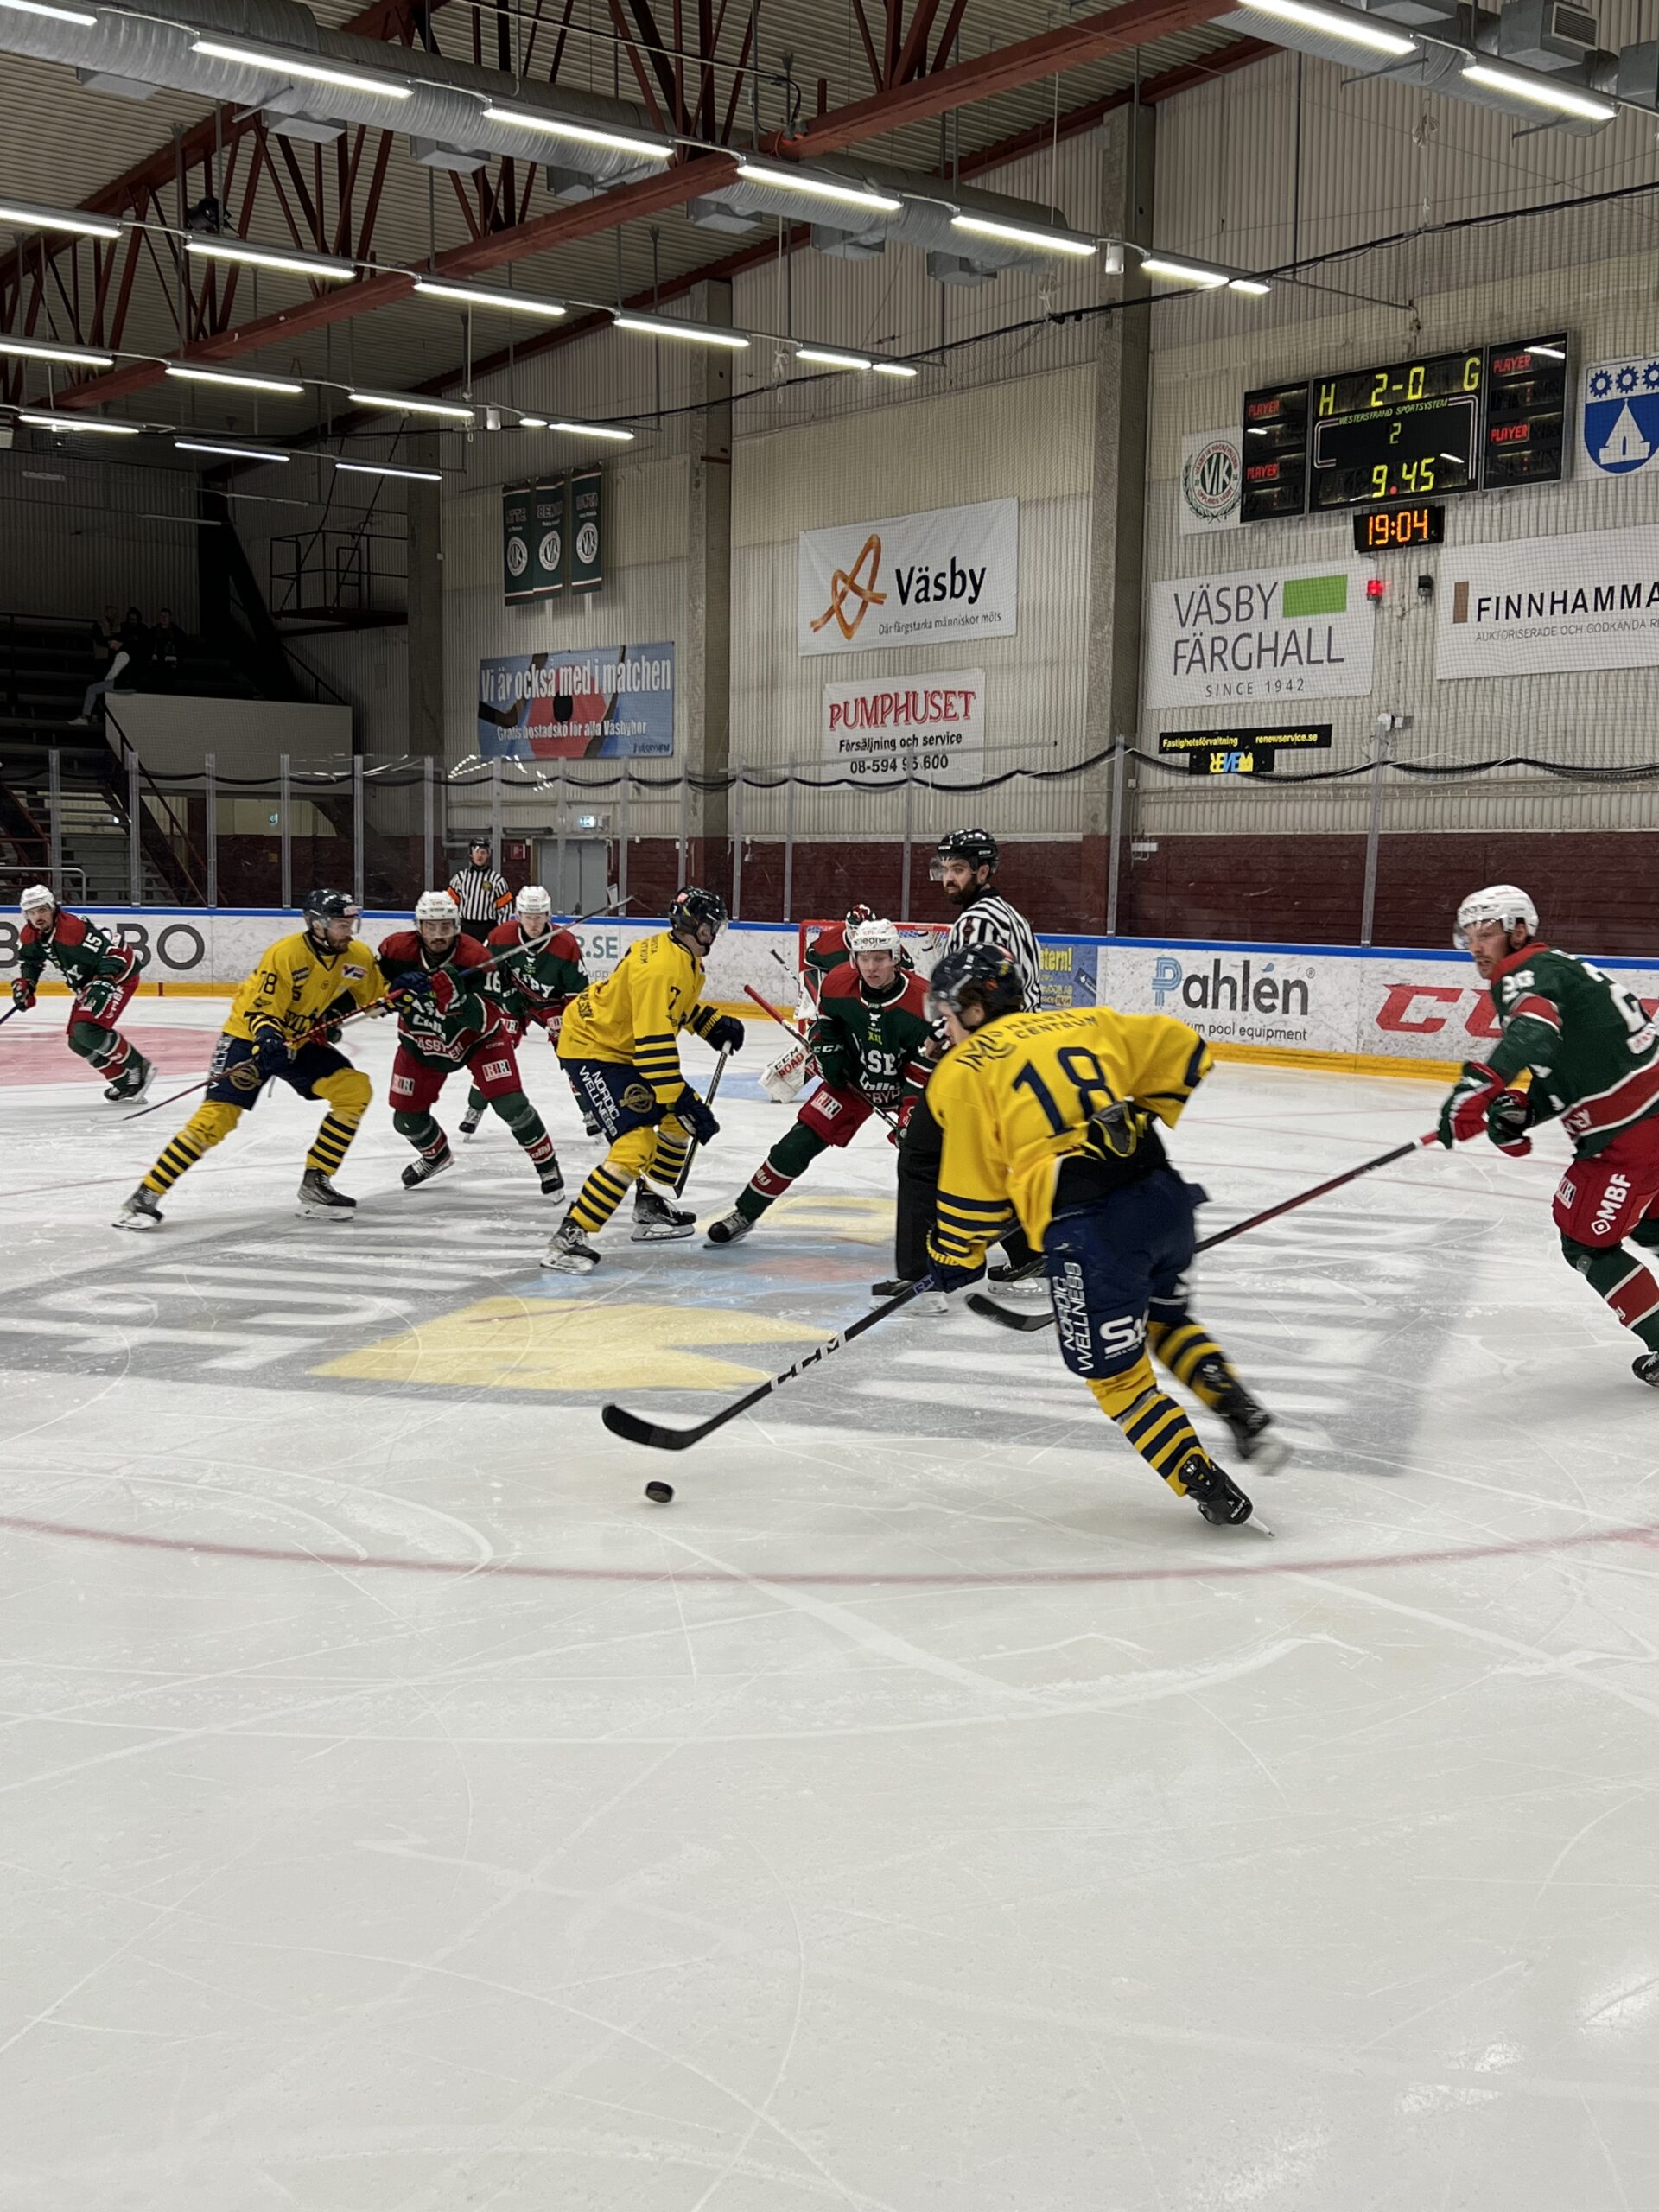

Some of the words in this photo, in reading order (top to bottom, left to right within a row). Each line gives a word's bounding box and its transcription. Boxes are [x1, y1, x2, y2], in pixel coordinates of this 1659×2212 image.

[1493, 355, 1531, 373] PLAYER
[1319, 383, 1336, 416] H
[1371, 366, 1425, 407] 2-0
[1463, 357, 1480, 391] G
[1248, 399, 1280, 416] PLAYER
[1339, 408, 1393, 425] WESTERSTRAND
[1395, 398, 1449, 415] SPORTSYSTEM
[1389, 423, 1401, 444] 2
[1491, 423, 1528, 443] PLAYER
[1247, 463, 1280, 480] PLAYER
[1369, 509, 1428, 545] 19:04
[895, 556, 987, 606] Väsby
[1173, 582, 1278, 628] VÄSBY
[879, 623, 893, 635] Där
[893, 620, 932, 635] färgstarka
[934, 615, 980, 628] människor
[982, 612, 1001, 623] möts
[1476, 626, 1556, 641] AUKTORISERADE
[1560, 624, 1583, 636] OCH
[1586, 619, 1646, 634] GODKÄNDA
[1173, 626, 1345, 676] FÄRGHALL
[480, 667, 494, 702] Vi
[497, 666, 512, 701] är
[515, 658, 556, 700] också
[560, 659, 591, 696] med
[594, 658, 599, 695] i
[602, 655, 671, 693] matchen
[1205, 682, 1254, 697] SINCE
[1265, 678, 1305, 693] 1942
[830, 690, 976, 731] PUMPHUSET
[497, 724, 522, 741] Gratis
[523, 721, 568, 740] bostadskö
[570, 721, 582, 737] för
[584, 721, 601, 737] alla
[839, 736, 897, 753] Försäljning
[899, 734, 919, 748] och
[922, 731, 963, 747] service
[1162, 735, 1238, 748] Fastighetsförvaltning
[1255, 733, 1318, 743] renewservice.se
[850, 758, 898, 774] 08-594
[923, 754, 949, 769] 600
[82, 932, 103, 953] 15
[484, 971, 501, 994] 16
[1152, 957, 1309, 1016] Pahlén
[670, 986, 681, 1011] 7
[1014, 1015, 1100, 1039] CENTRUM
[1209, 1022, 1236, 1037] pool
[1239, 1027, 1307, 1042] equipment
[778, 1052, 804, 1078] ROAD
[579, 1065, 618, 1137] WELLNESS
[592, 1071, 620, 1120] NORDIC
[1012, 1046, 1116, 1135] 18
[1052, 1276, 1076, 1351] NORDIC
[1064, 1262, 1094, 1370] WELLNESS
